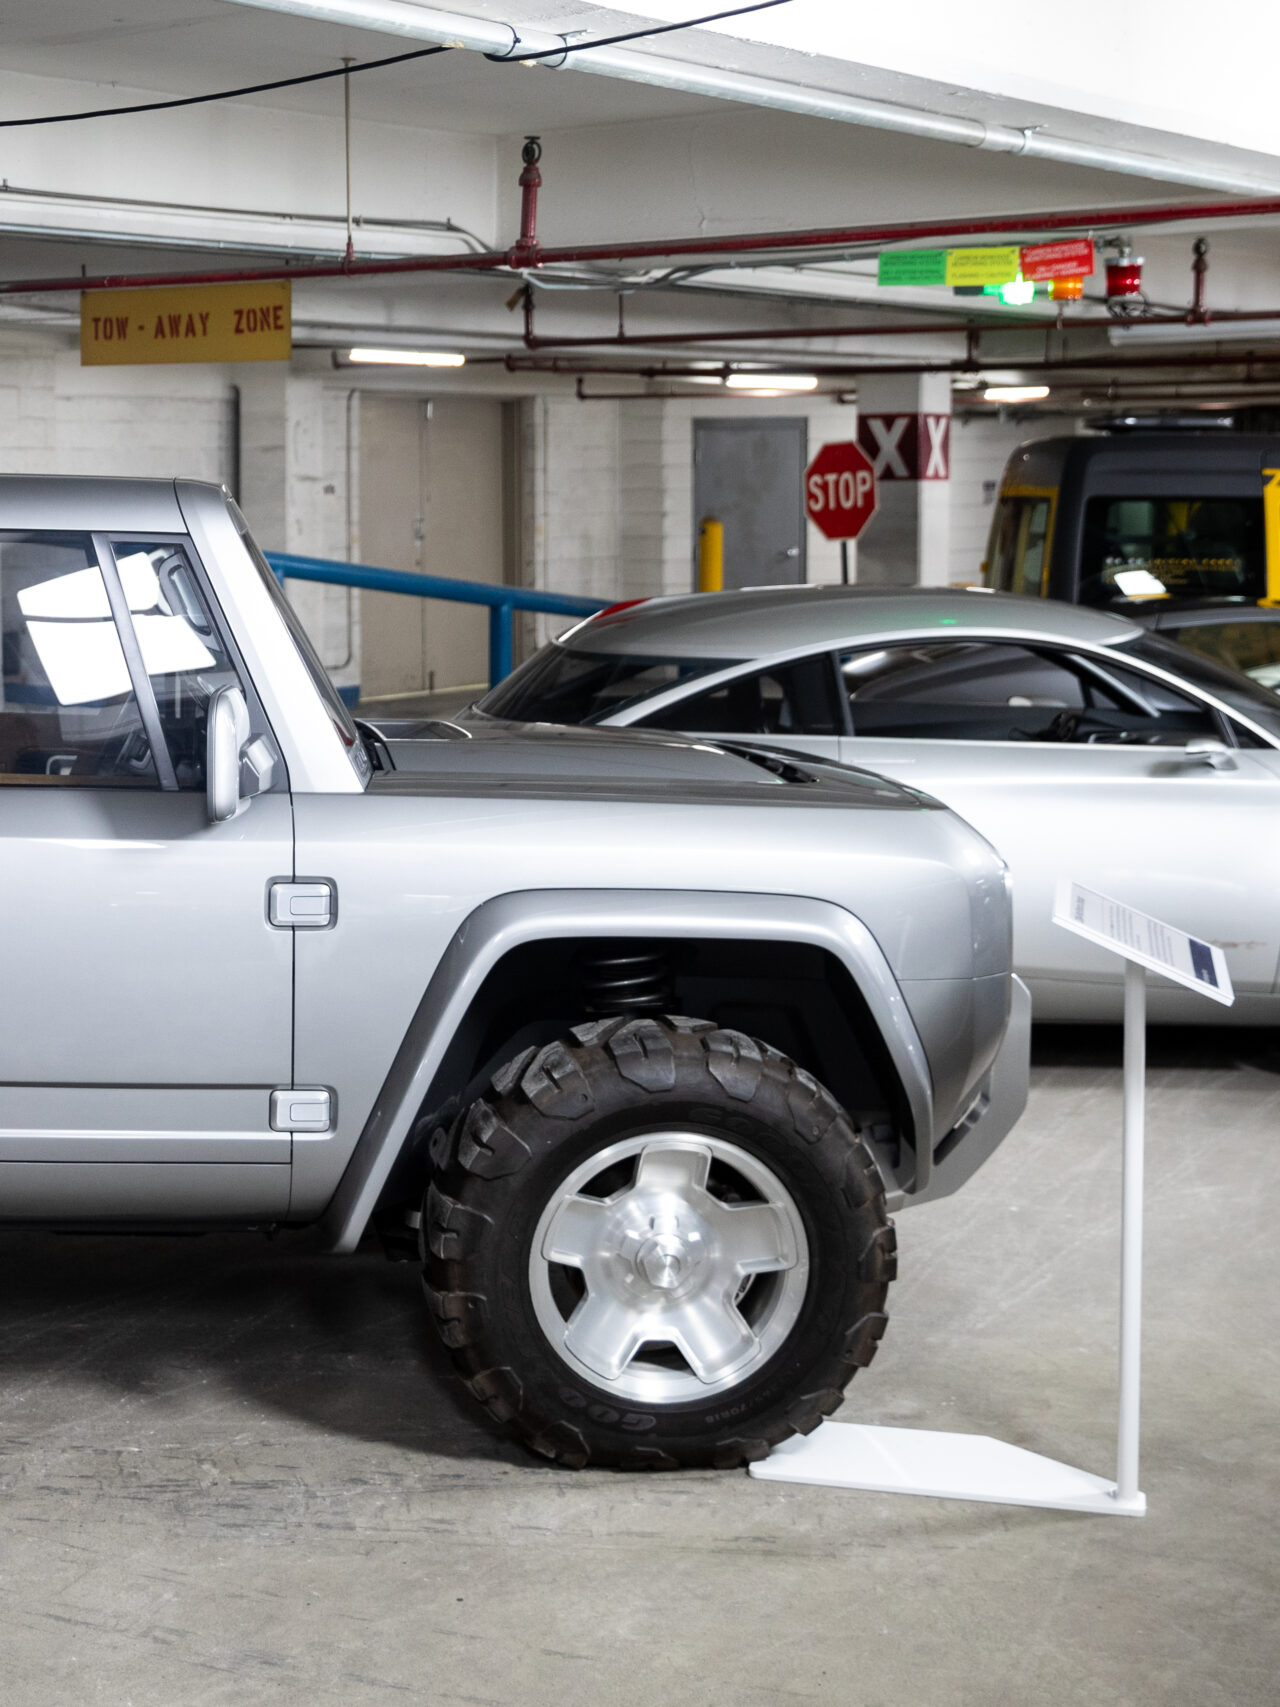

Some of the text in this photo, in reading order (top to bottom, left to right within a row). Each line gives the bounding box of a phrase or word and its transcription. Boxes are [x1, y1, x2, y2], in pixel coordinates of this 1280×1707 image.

[92, 317, 129, 341] TOW
[154, 312, 210, 340] AWAY
[234, 305, 284, 334] ZONE
[866, 417, 911, 478] X
[925, 416, 947, 478] X
[808, 469, 872, 512] STOP
